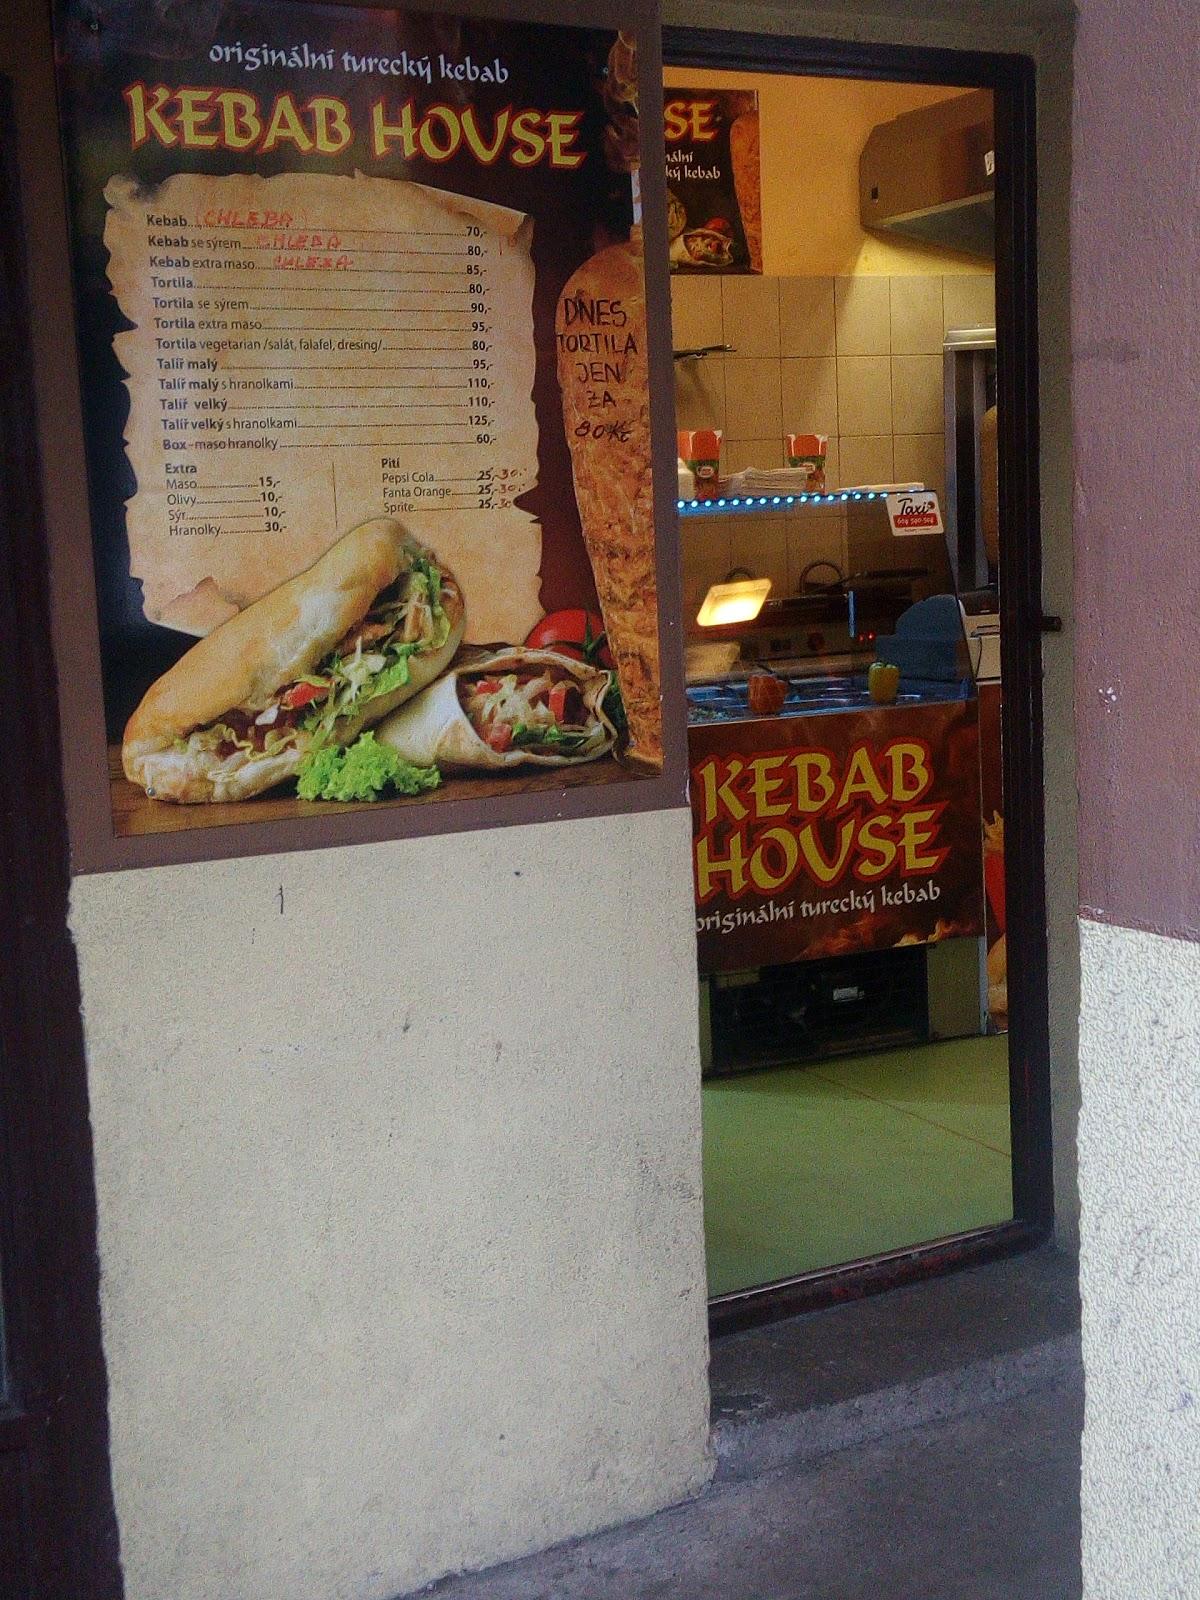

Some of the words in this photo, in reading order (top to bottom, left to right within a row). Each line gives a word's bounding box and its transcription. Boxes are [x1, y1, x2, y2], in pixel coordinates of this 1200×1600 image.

[209, 41, 335, 71] originální
[341, 50, 432, 84] turecký
[438, 53, 509, 83] kebab
[124, 81, 353, 155] KEBAB
[685, 165, 720, 180] kebab
[146, 214, 188, 227] Kebab
[466, 226, 487, 239] 70,-
[148, 235, 189, 248] Kebab
[191, 239, 204, 248] se
[206, 236, 242, 253] sýrem
[467, 245, 488, 257] 80,-
[149, 255, 190, 268] Kebab
[192, 257, 223, 269] extra
[223, 259, 255, 270] maso
[466, 264, 487, 277] 85,-
[151, 276, 193, 289] Tortila
[469, 283, 490, 295] 80,-
[152, 297, 194, 309] Tortila
[197, 300, 210, 309] se
[214, 297, 249, 312] sýrem
[471, 302, 492, 315] 90,-
[563, 298, 628, 327] DNES
[154, 317, 195, 329] Tortila
[198, 319, 228, 330] extra
[231, 320, 262, 330] maso
[471, 322, 493, 334] 95,-
[154, 337, 197, 349] Tortila
[200, 338, 261, 353] vegetarian
[471, 340, 493, 352] 80,-
[557, 332, 639, 355] TORTILA
[157, 358, 184, 370] Talíř
[187, 358, 218, 372] malý
[473, 359, 494, 371] 95,-
[575, 362, 622, 384] JEN
[158, 378, 186, 390] Talíř
[188, 378, 219, 392] malý
[221, 381, 227, 389] s
[229, 378, 294, 390] hranolkami
[468, 377, 495, 389] 110,-
[194, 398, 228, 412] velký
[468, 396, 496, 408] 110,-
[161, 418, 189, 430] Talíř
[191, 417, 224, 432] velký
[226, 421, 232, 429] s
[233, 417, 298, 429] hranolkami
[468, 415, 496, 427] 125,-
[162, 439, 187, 450] Box
[476, 433, 497, 445] 60,-
[165, 463, 197, 474] Extra
[166, 479, 198, 490] Maso
[258, 476, 281, 488] 15,-
[382, 472, 409, 485] Pepsi
[412, 472, 434, 482] Cola
[166, 493, 197, 507] Olivy
[260, 491, 282, 503] 10,-
[383, 487, 411, 498] Fanta
[413, 486, 452, 499] Orange
[168, 509, 186, 523] Sýr
[264, 506, 286, 518] 10,-
[384, 502, 414, 515] Sprite
[897, 497, 929, 515] Taxi
[169, 524, 221, 538] Hranolky
[264, 521, 287, 533] 30,-
[696, 739, 932, 825] KEBAB
[695, 900, 794, 935] originální
[800, 889, 875, 918] turecký
[881, 879, 941, 906] kebab
